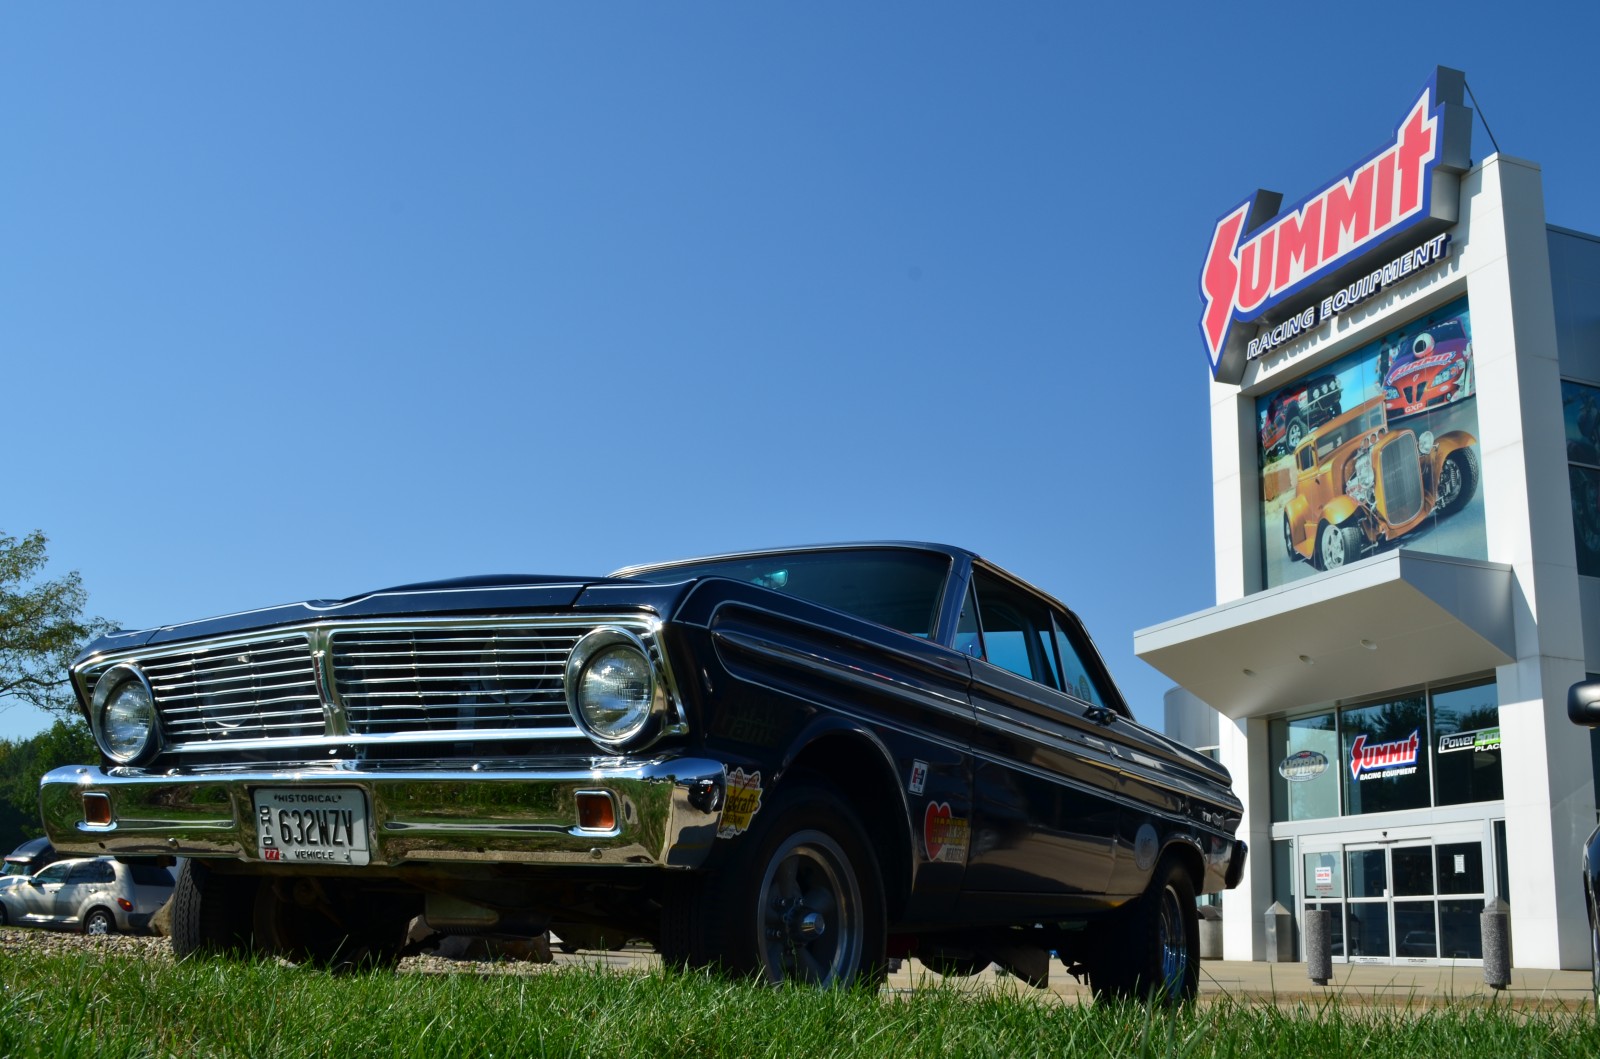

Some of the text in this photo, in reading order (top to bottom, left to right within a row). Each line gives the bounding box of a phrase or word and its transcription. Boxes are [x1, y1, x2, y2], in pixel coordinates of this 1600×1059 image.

[1246, 233, 1446, 360] RACING EQUIPMENT
[1404, 402, 1424, 413] GXP
[1475, 743, 1500, 752] PLAC
[1360, 766, 1417, 781] RACING EQUIPMENT
[259, 805, 273, 846] OHIO
[278, 809, 353, 846] 632WZV
[265, 849, 278, 858] 77
[294, 850, 335, 860] VEHICLE
